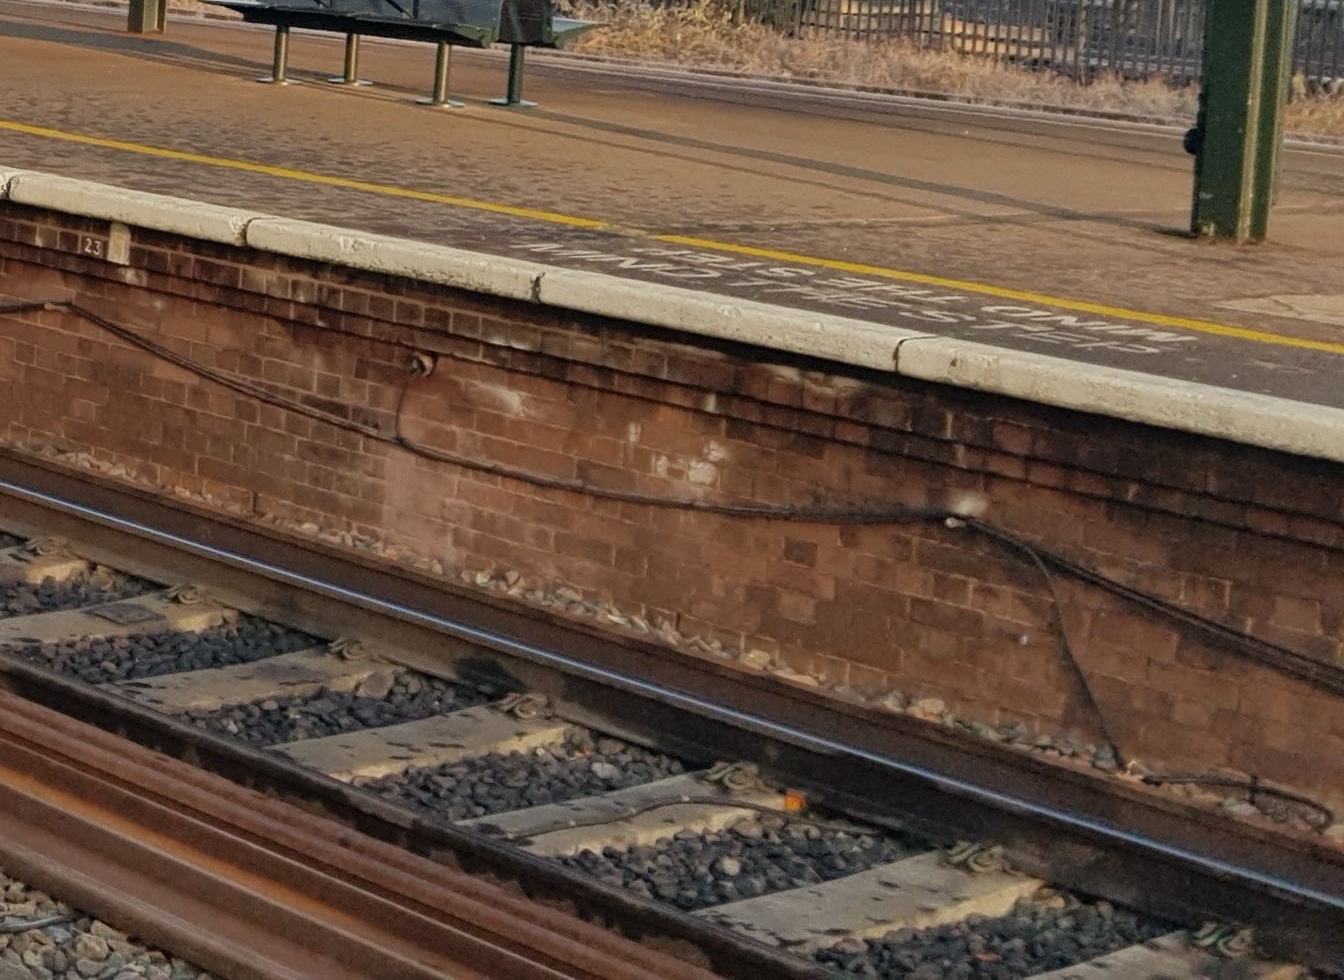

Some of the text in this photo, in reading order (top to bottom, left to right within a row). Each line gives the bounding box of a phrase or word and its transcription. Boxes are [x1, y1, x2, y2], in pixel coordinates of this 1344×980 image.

[84, 237, 101, 256] 23
[508, 242, 1161, 355] MIND THE STEP
[631, 247, 1198, 343] MIND THE STEP
